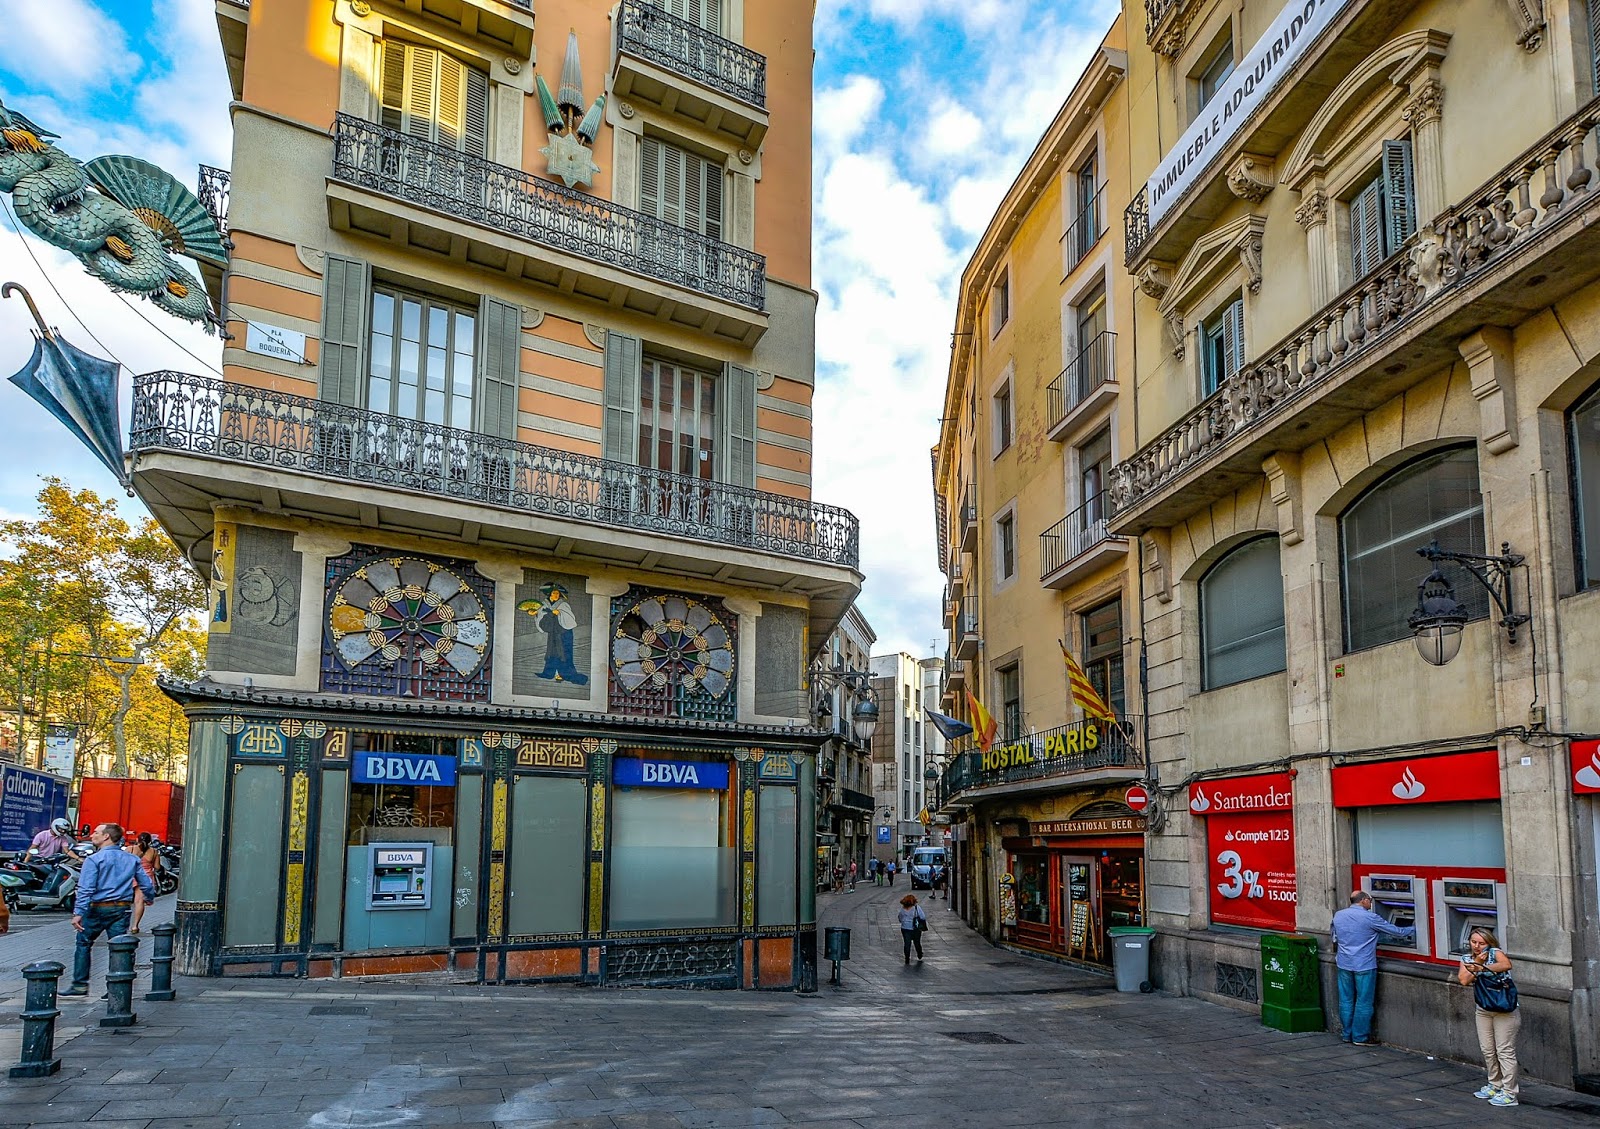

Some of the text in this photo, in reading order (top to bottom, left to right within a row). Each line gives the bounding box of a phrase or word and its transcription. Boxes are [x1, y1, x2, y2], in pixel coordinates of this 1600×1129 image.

[1152, 0, 1316, 207] INMUEBLE ADQUIRIDO
[271, 329, 282, 337] PLA
[277, 338, 285, 346] LA
[259, 343, 291, 356] BOQUERIA
[982, 724, 1098, 771] HOSTAL PARIS
[366, 757, 441, 781] BBVA
[642, 763, 699, 784] BBVA
[6, 771, 46, 798] atlanta
[1213, 785, 1291, 810] Santander
[879, 827, 888, 835] P
[1038, 819, 1132, 833] BAR INTERNATIONAL BEER
[1235, 830, 1269, 844] Compte
[387, 854, 414, 862] BBVA
[1217, 850, 1264, 898] 3%
[1267, 889, 1297, 902] 15.000
